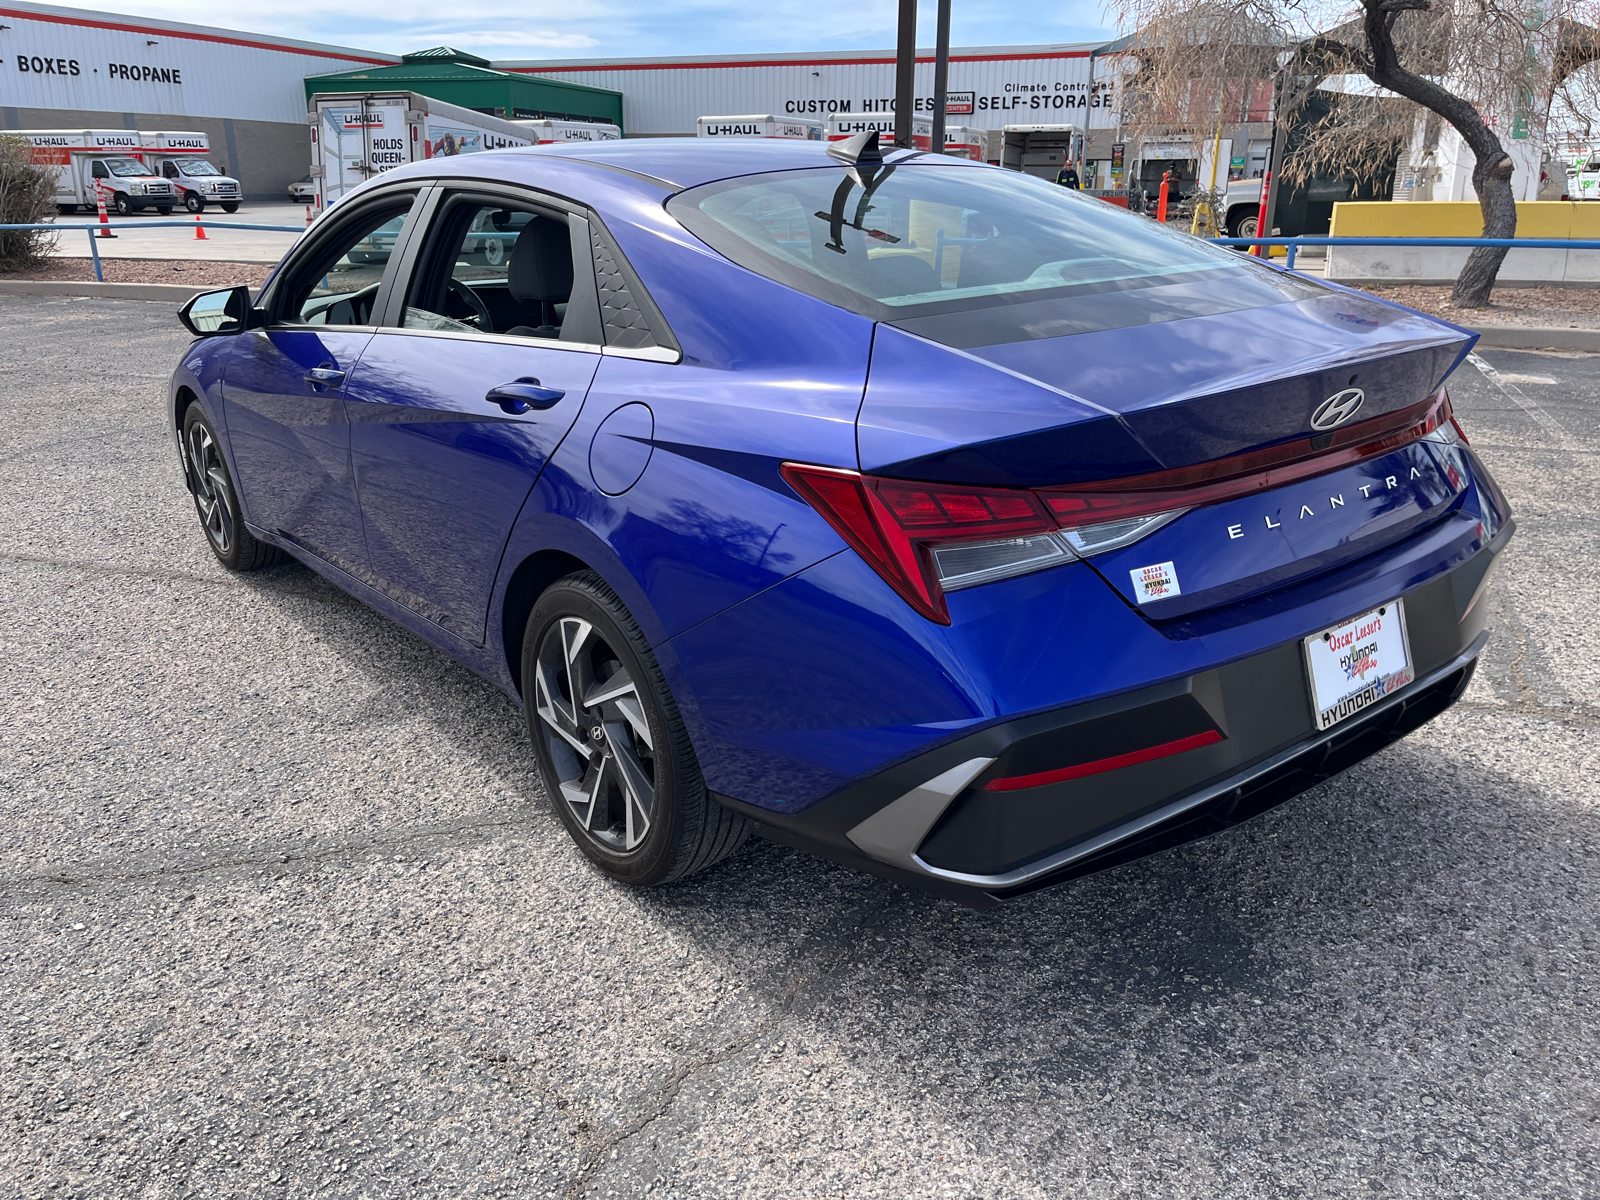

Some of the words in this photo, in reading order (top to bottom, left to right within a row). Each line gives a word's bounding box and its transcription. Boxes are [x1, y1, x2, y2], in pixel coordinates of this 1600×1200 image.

[17, 55, 80, 76] BOXES
[108, 63, 182, 84] PROPANE
[1004, 82, 1047, 92] Climate
[785, 99, 851, 113] CUSTOM
[978, 94, 1112, 110] SELF-STORAGE
[344, 113, 382, 123] U-HAUL
[707, 124, 761, 135] U-HAUL
[783, 125, 804, 136] U-HAUL
[839, 122, 895, 132] U-HAUL
[565, 129, 592, 140] U-HAUL
[34, 137, 68, 145] U-HAUL
[96, 137, 136, 146] U-HAUL
[168, 139, 204, 147] U-HAUL
[373, 138, 403, 150] HOLDS
[371, 152, 405, 164] QUEEN-
[1227, 466, 1421, 540] ELANTRA
[1143, 566, 1162, 575] OSCAR
[1144, 578, 1171, 589] HYUNDAI
[1329, 632, 1353, 652] Oscar
[1354, 616, 1381, 641] Leeser's
[1340, 641, 1378, 668] HYUNDAI
[1321, 687, 1376, 727] HYUNDAI
